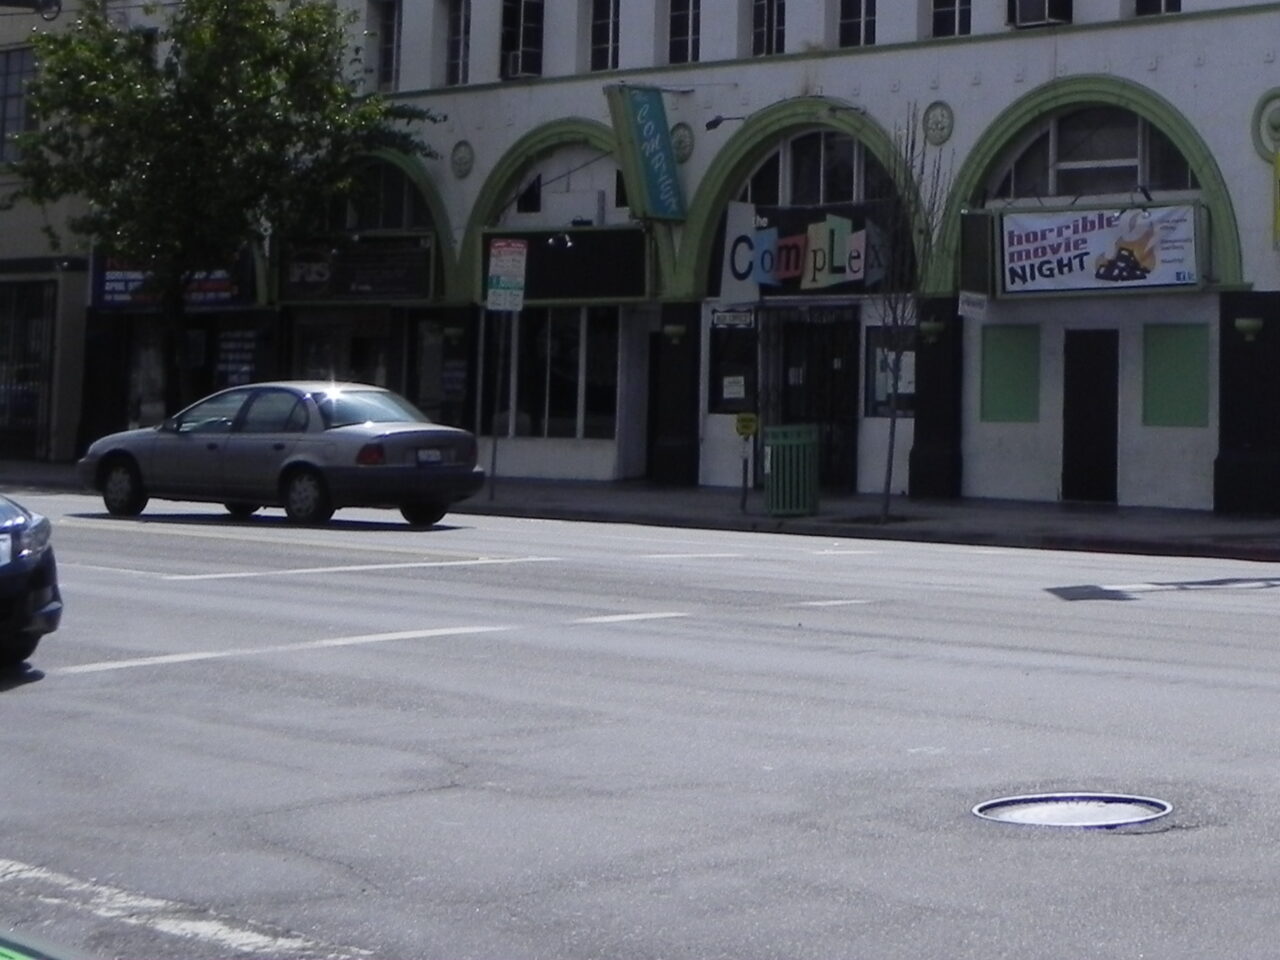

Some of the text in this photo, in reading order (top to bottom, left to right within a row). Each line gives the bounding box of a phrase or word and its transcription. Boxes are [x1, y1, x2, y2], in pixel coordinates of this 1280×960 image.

[1007, 212, 1120, 248] horrible
[1008, 237, 1088, 264] movie
[1008, 251, 1090, 285] NIGHT
